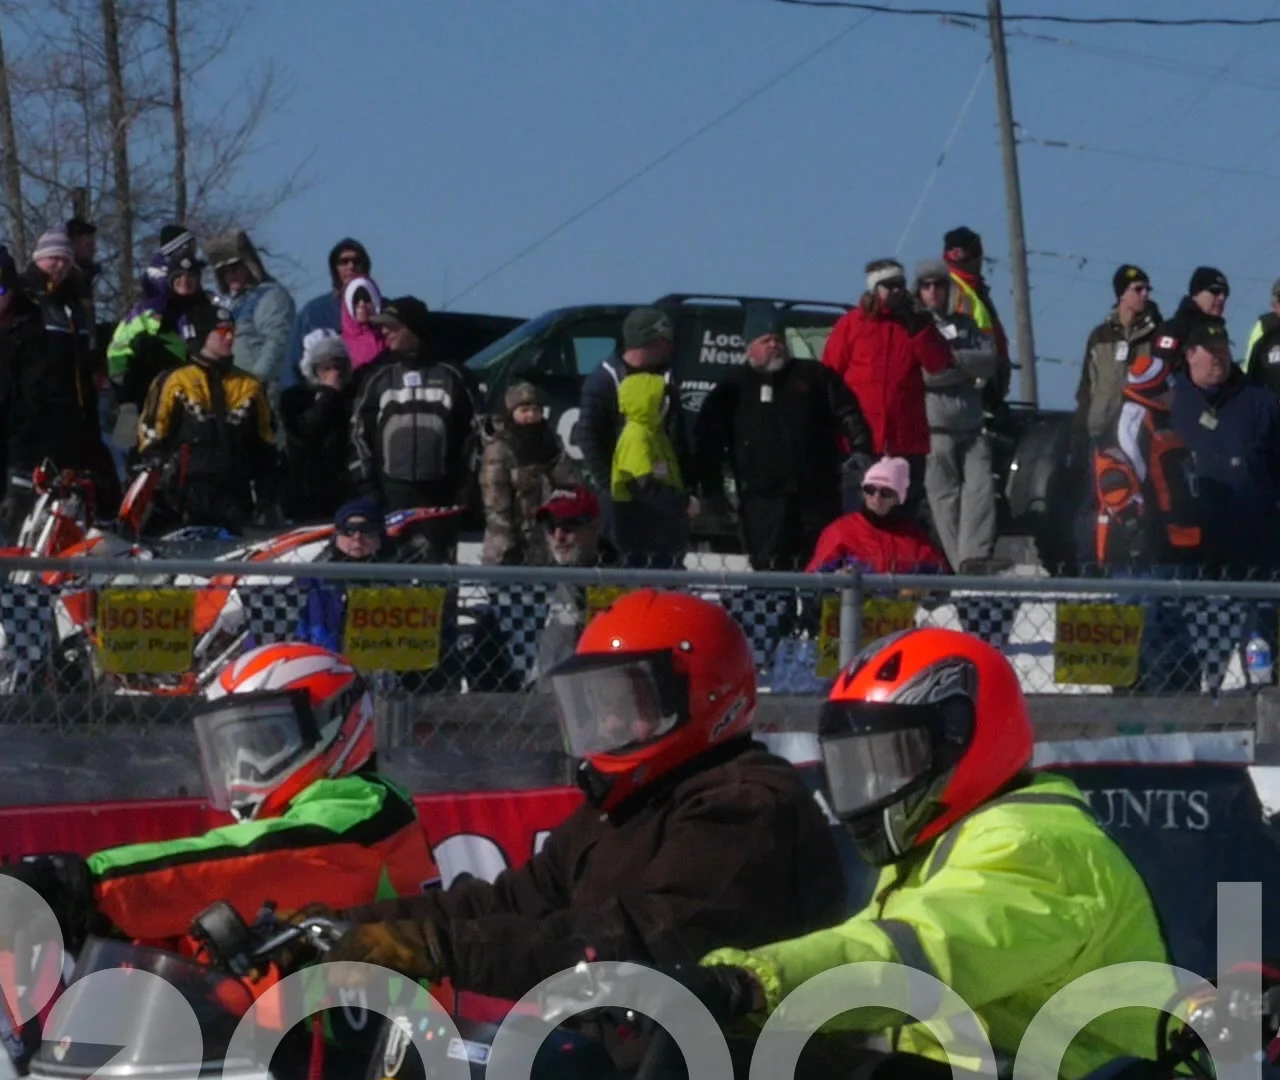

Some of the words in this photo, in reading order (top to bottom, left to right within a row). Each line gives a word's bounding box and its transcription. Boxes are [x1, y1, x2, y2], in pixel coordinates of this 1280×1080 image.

[703, 330, 745, 346] Loc
[699, 348, 747, 364] New
[102, 608, 189, 630] BOSCH
[352, 607, 437, 629] BOSCH
[1059, 622, 1139, 645] BOSCH
[1082, 788, 1210, 831] UNTS
